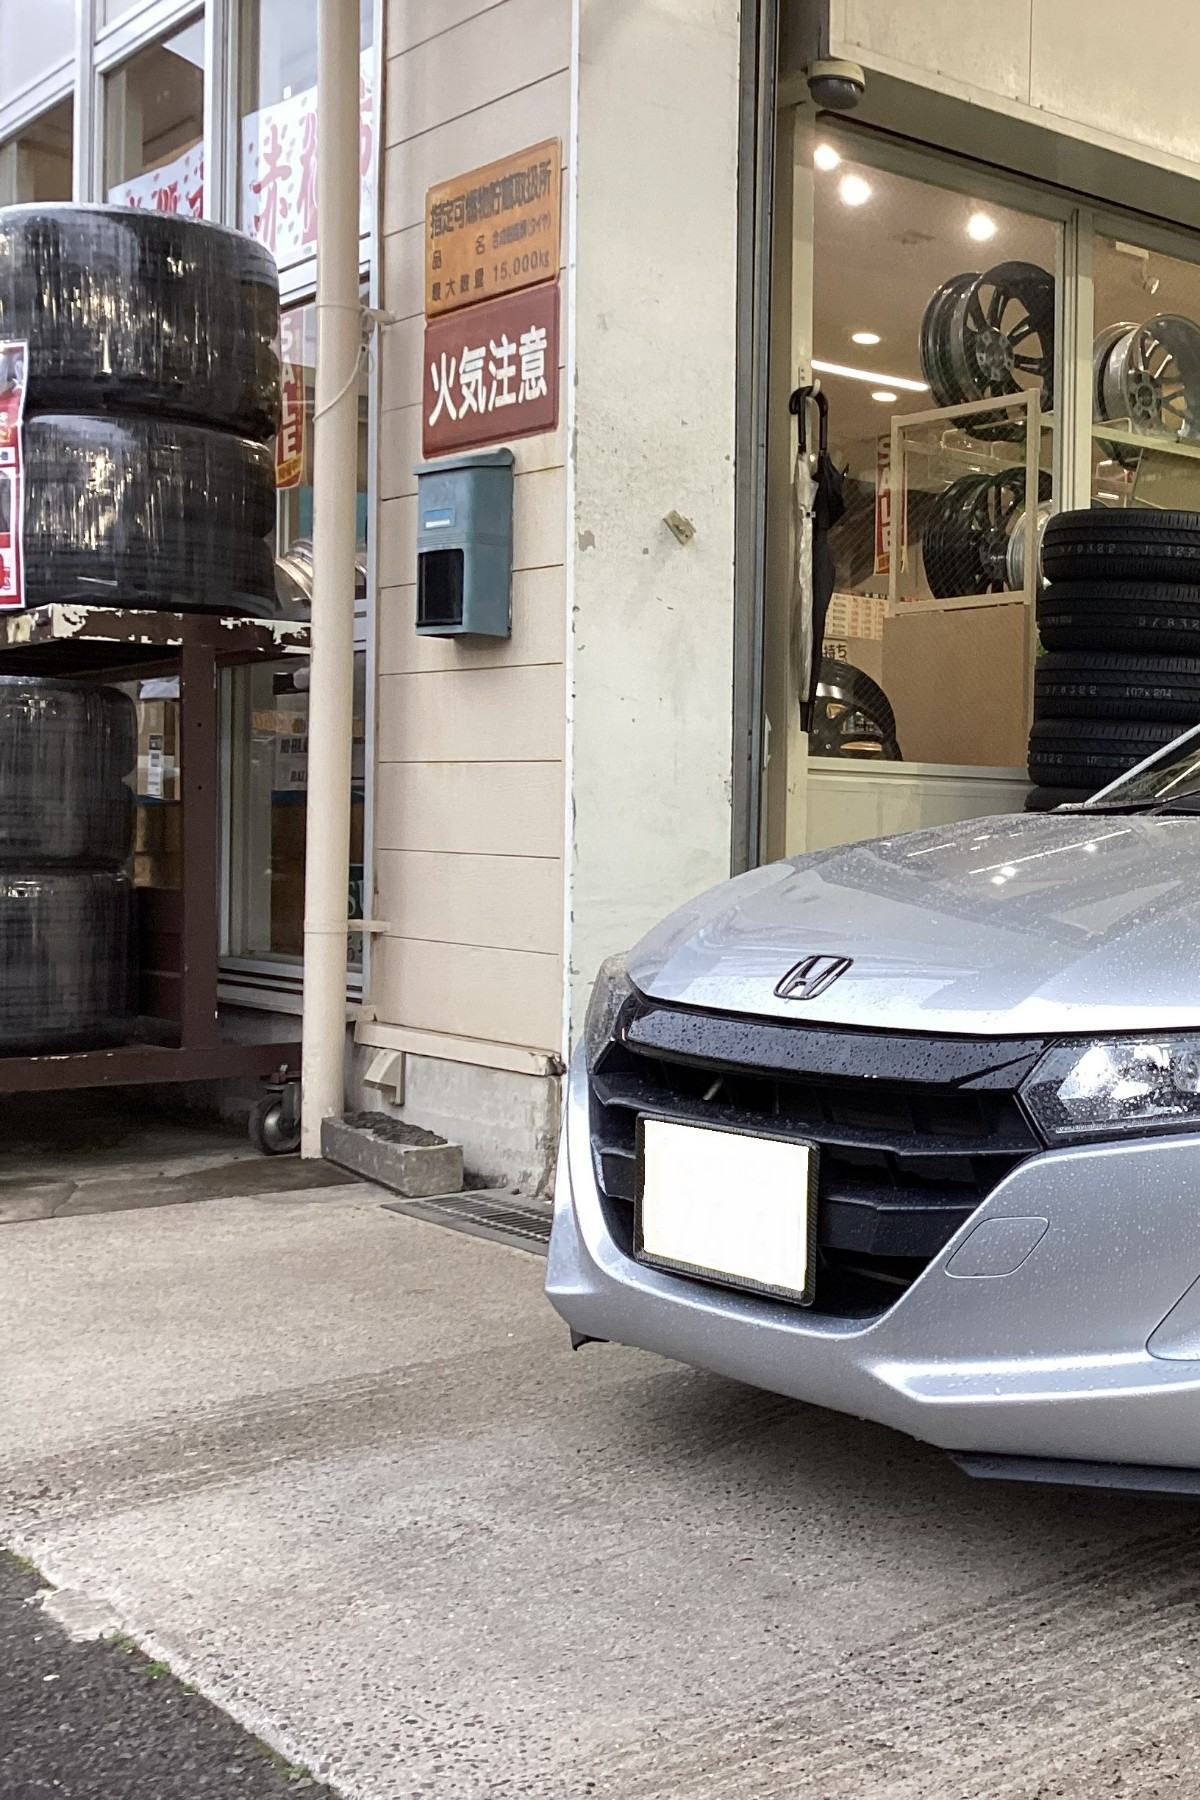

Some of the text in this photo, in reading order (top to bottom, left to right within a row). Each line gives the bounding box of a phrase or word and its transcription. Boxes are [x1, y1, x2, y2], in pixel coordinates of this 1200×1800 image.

[493, 249, 550, 283] 15,000kg
[281, 317, 297, 462] SALE
[428, 325, 548, 427] 火気注意
